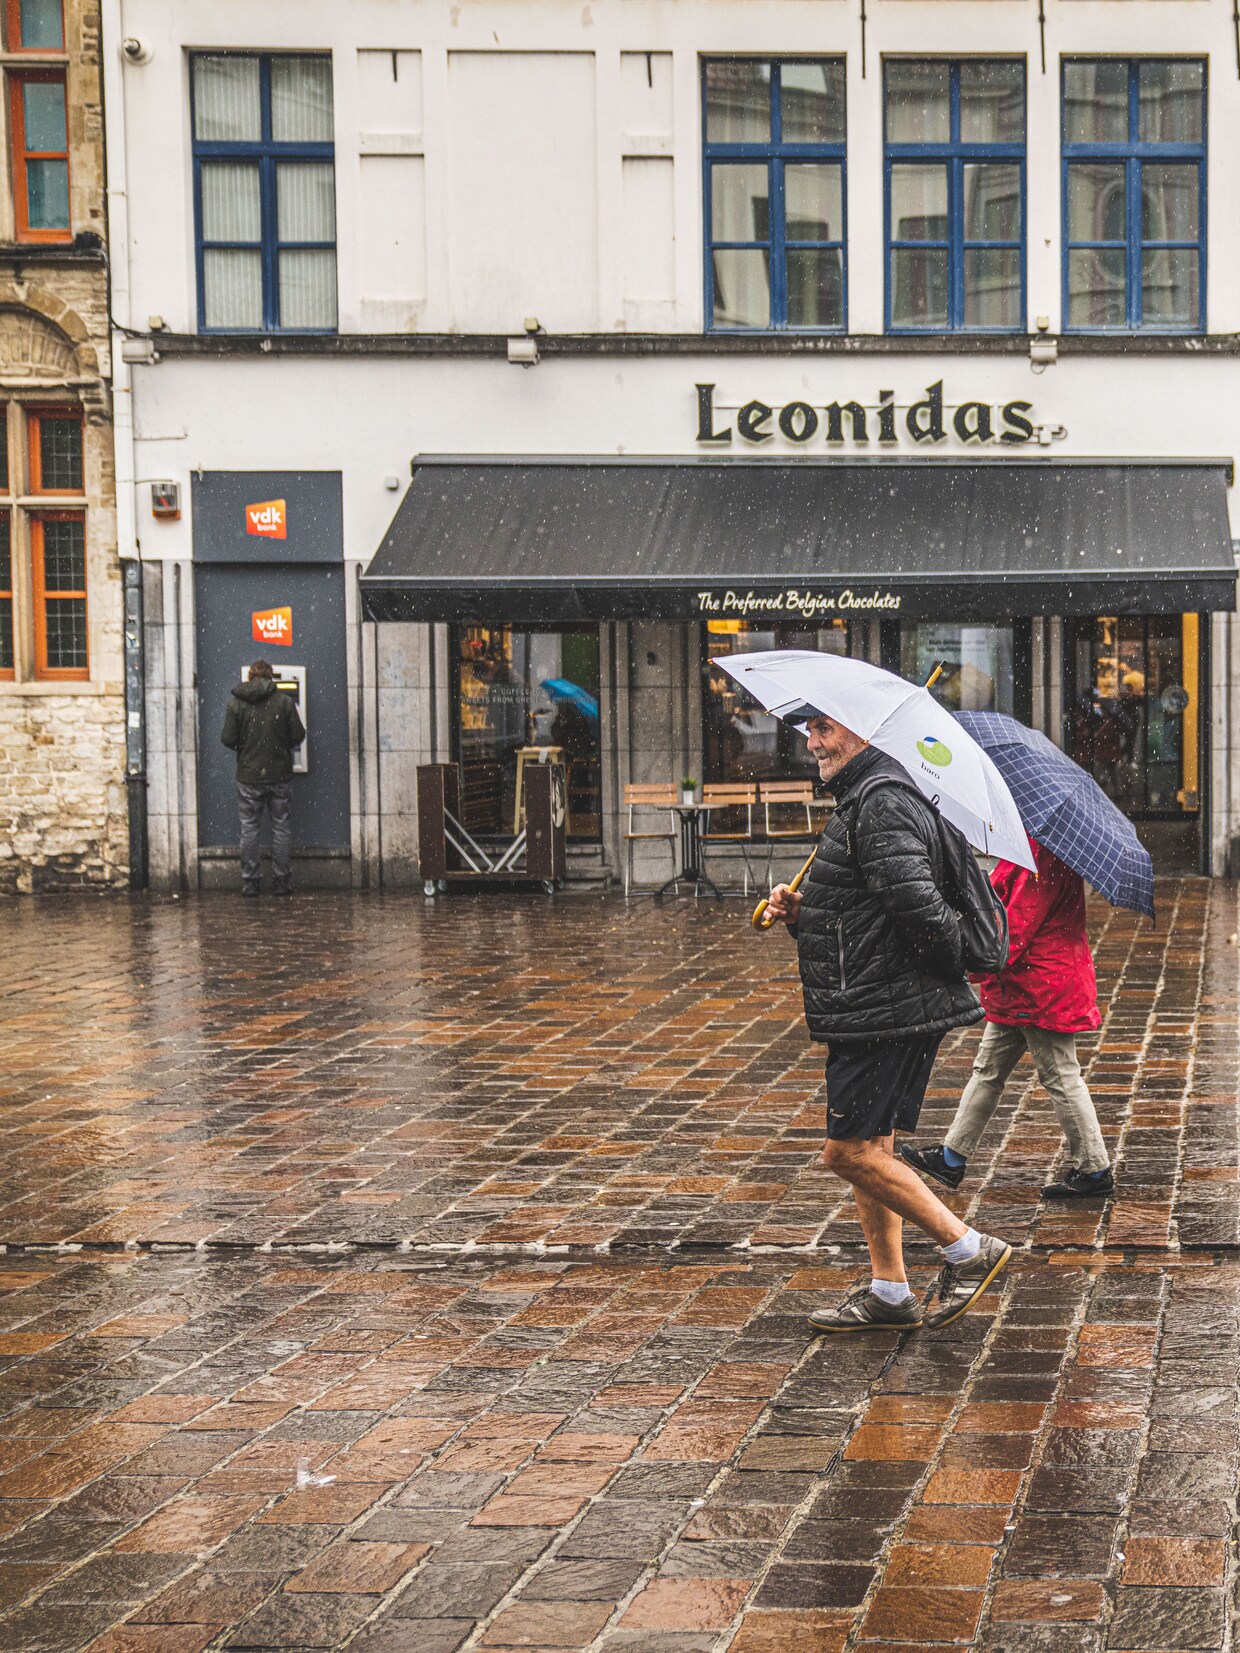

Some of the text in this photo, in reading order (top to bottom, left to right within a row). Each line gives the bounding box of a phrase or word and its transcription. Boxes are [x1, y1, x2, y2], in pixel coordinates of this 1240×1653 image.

[695, 379, 1034, 442] Leonidas
[249, 507, 282, 523] vdk
[698, 589, 901, 617] The Preferred Belgian Chocolates
[256, 614, 288, 630] vdk
[920, 762, 940, 780] baro
